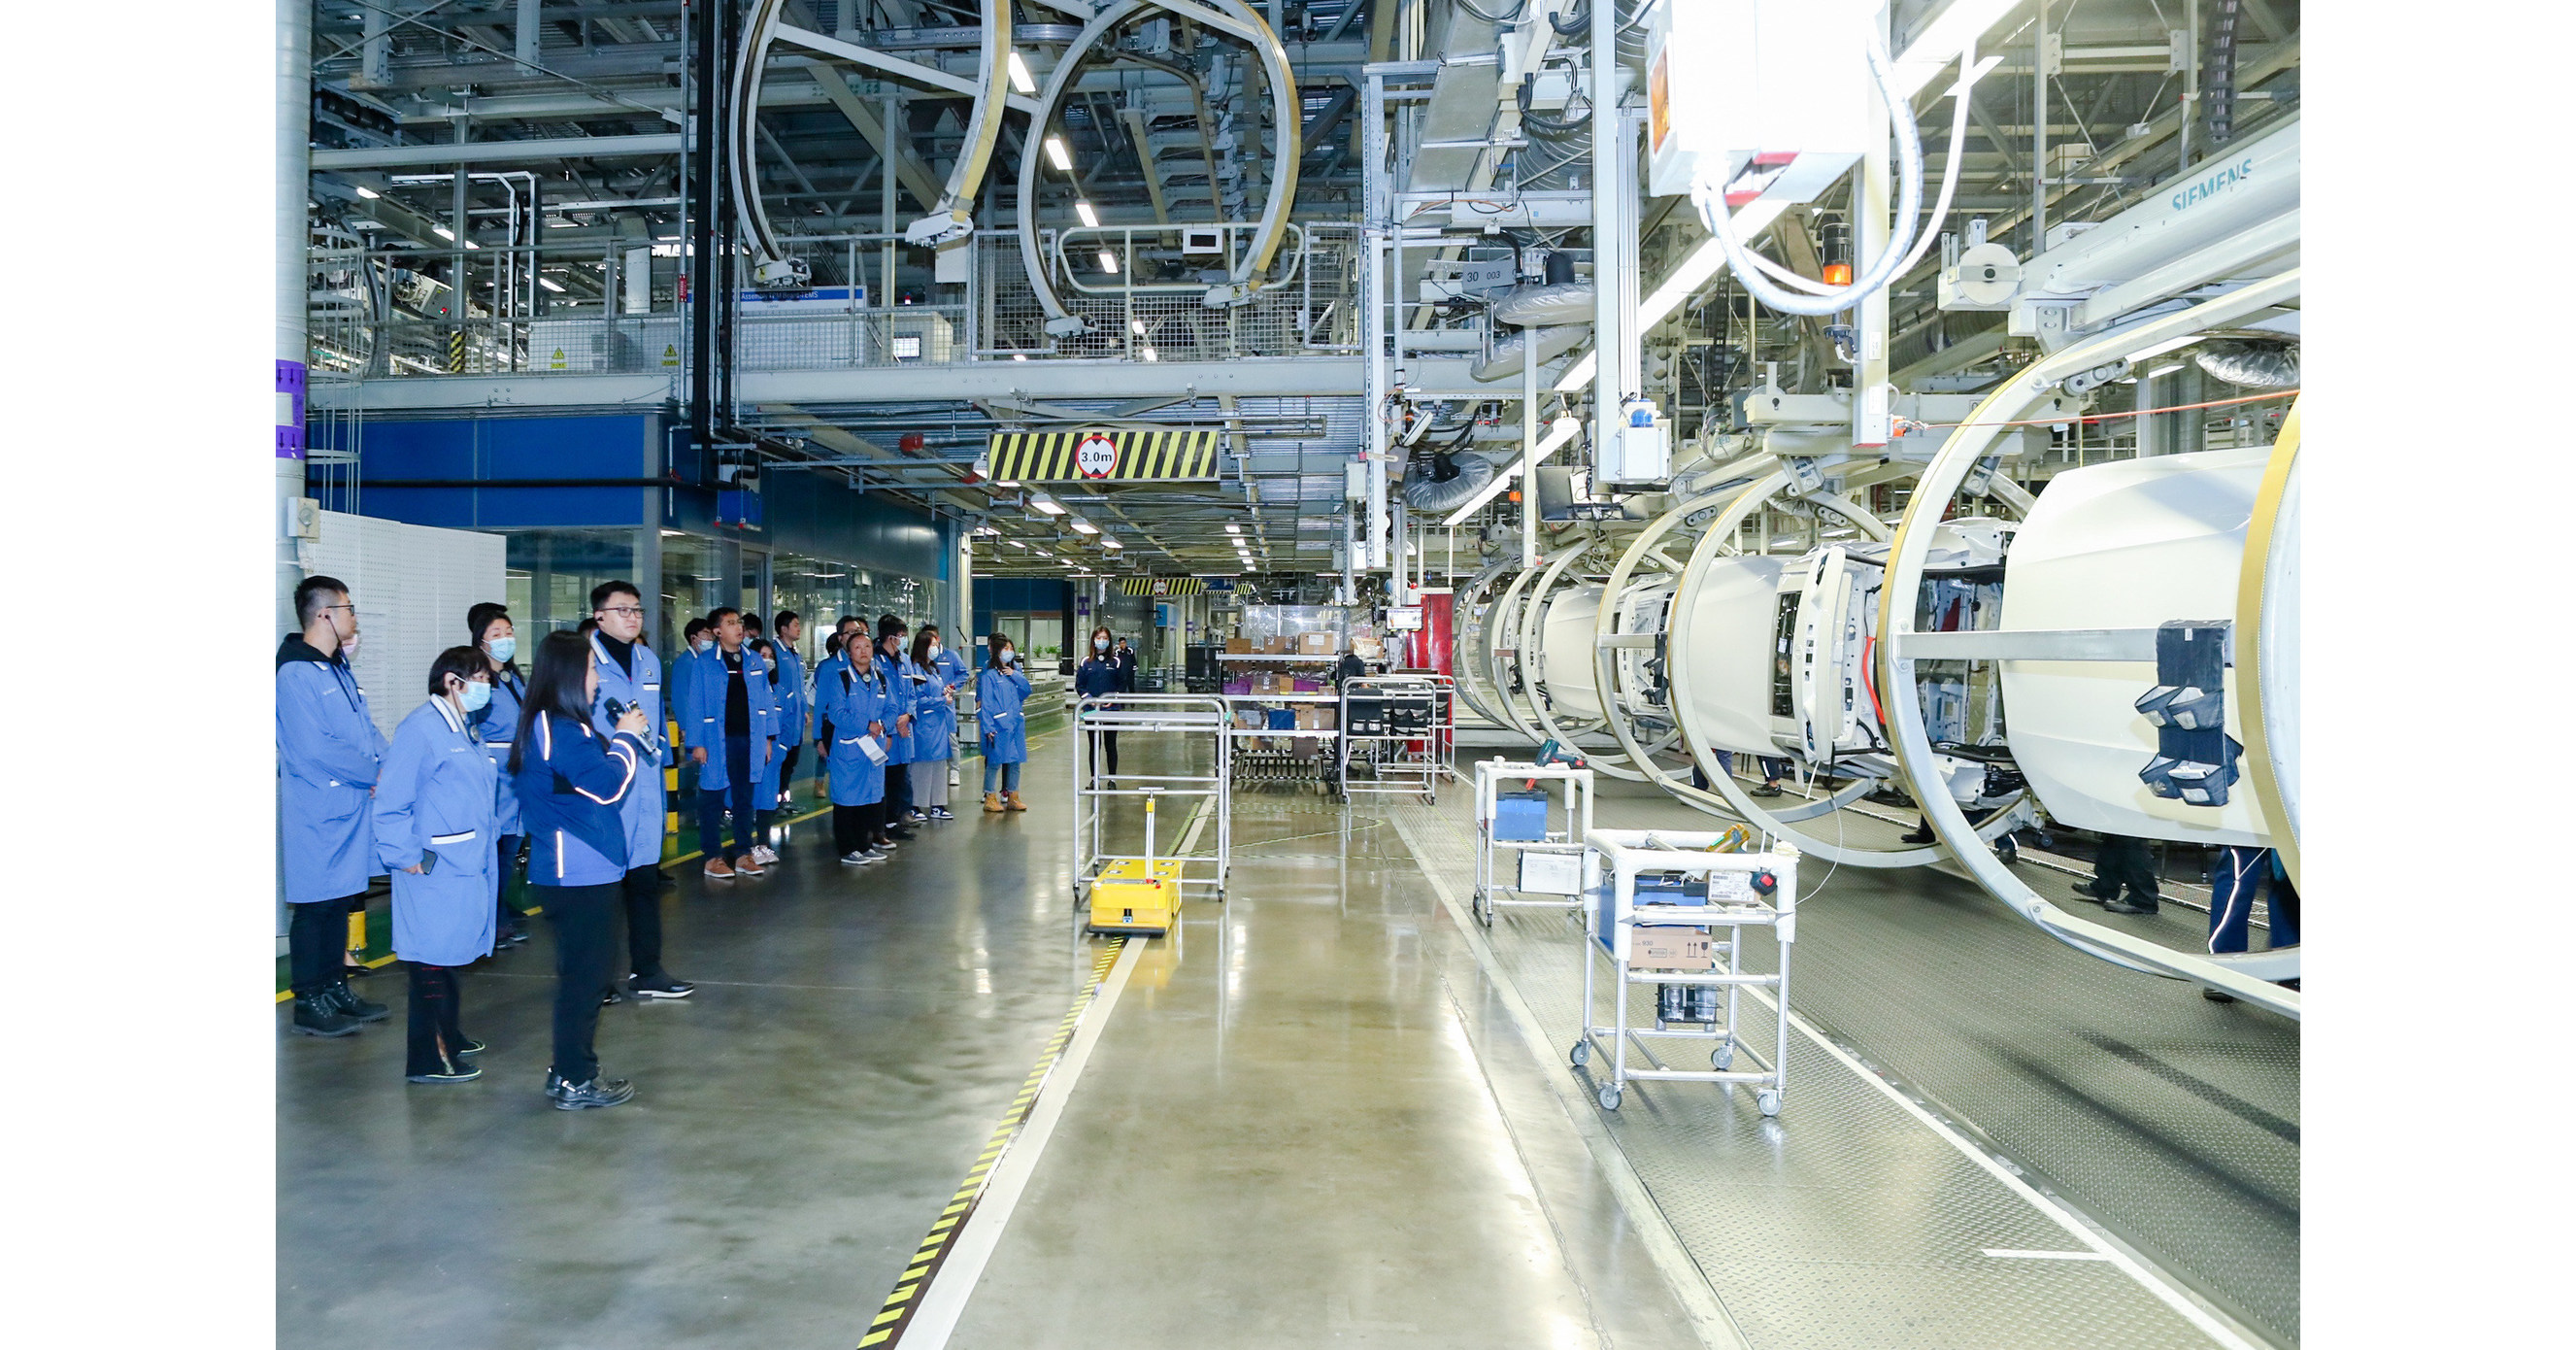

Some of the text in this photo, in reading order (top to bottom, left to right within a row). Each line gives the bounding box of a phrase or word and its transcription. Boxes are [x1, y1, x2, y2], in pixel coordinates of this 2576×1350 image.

[1466, 271, 1479, 283] 30
[1487, 270, 1501, 280] 003
[1081, 452, 1113, 462] 3.0m
